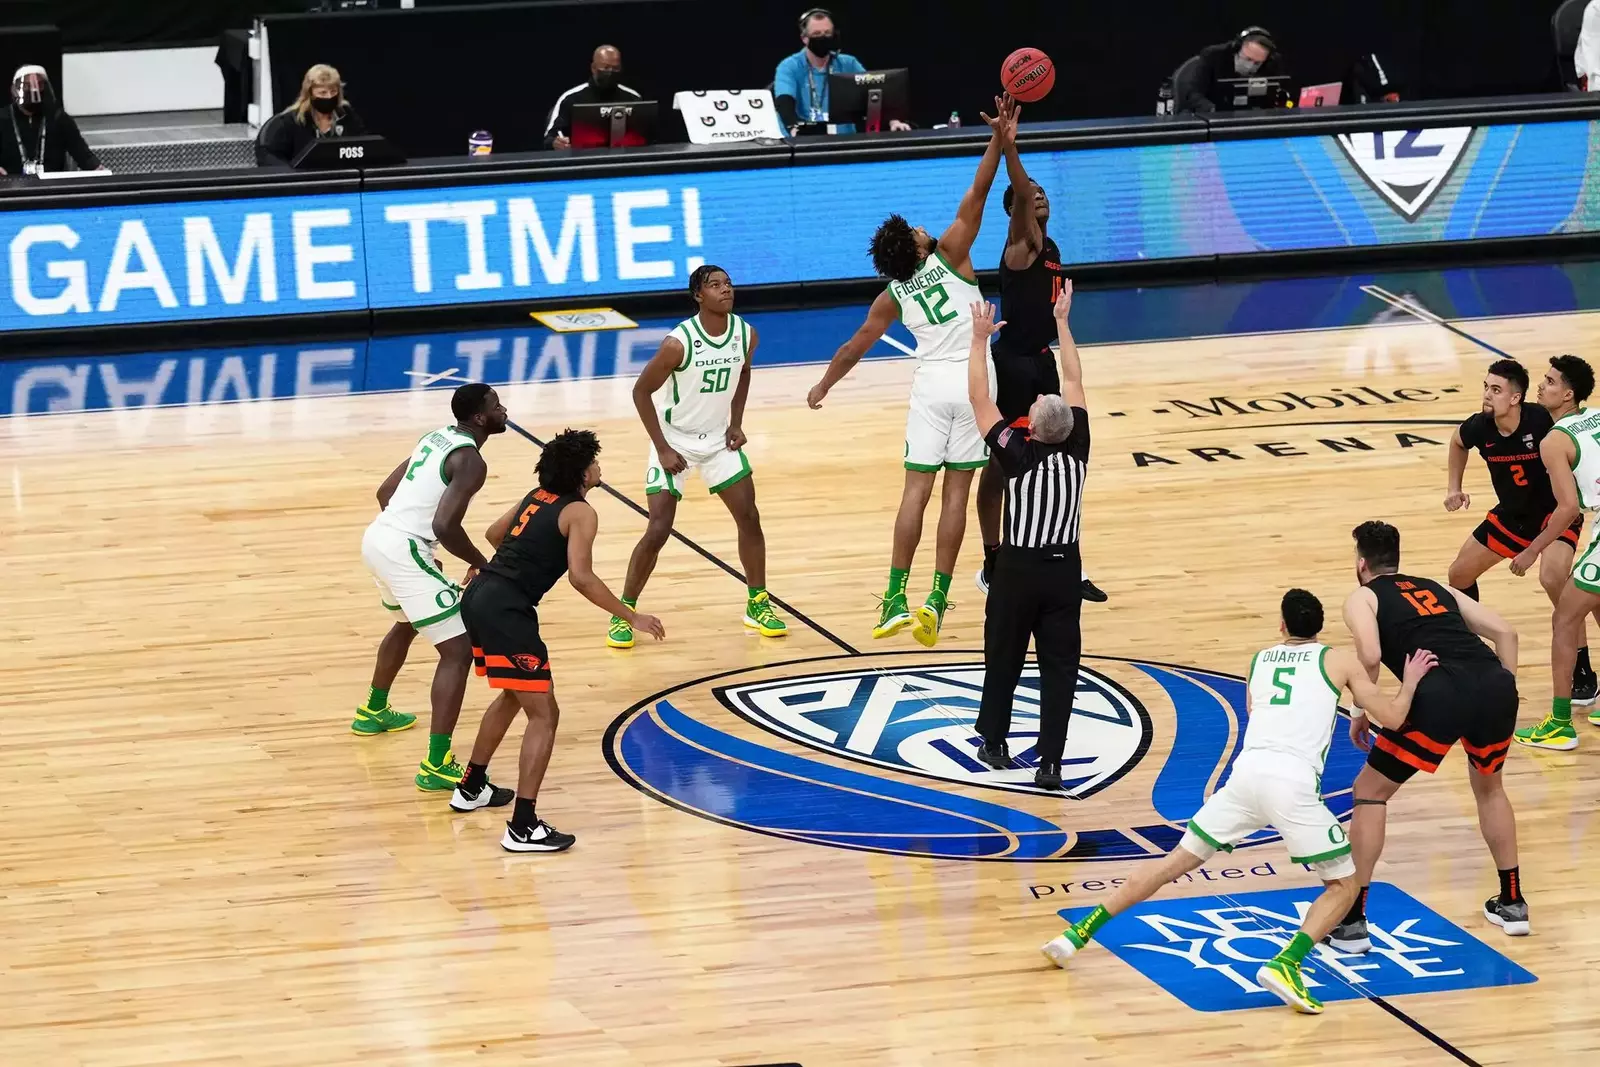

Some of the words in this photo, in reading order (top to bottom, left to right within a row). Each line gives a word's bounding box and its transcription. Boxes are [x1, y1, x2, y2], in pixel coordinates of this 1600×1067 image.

[1009, 54, 1032, 73] NCAA
[1014, 64, 1047, 88] Wilson
[339, 146, 364, 159] POSS
[9, 209, 357, 316] GAME
[384, 187, 706, 293] TIME!
[913, 283, 959, 326] 12
[695, 356, 741, 368] DUCKS
[700, 367, 731, 394] 50
[1160, 386, 1440, 418] Mobile
[405, 445, 433, 481] 2
[1131, 432, 1446, 468] ARENA
[1510, 464, 1529, 486] 2
[510, 503, 540, 537] 5
[1400, 589, 1449, 617] 12
[1262, 650, 1313, 663] DUARTE
[1269, 667, 1296, 705] 5
[1028, 861, 1278, 900] presnted
[1121, 918, 1464, 970] YOK
